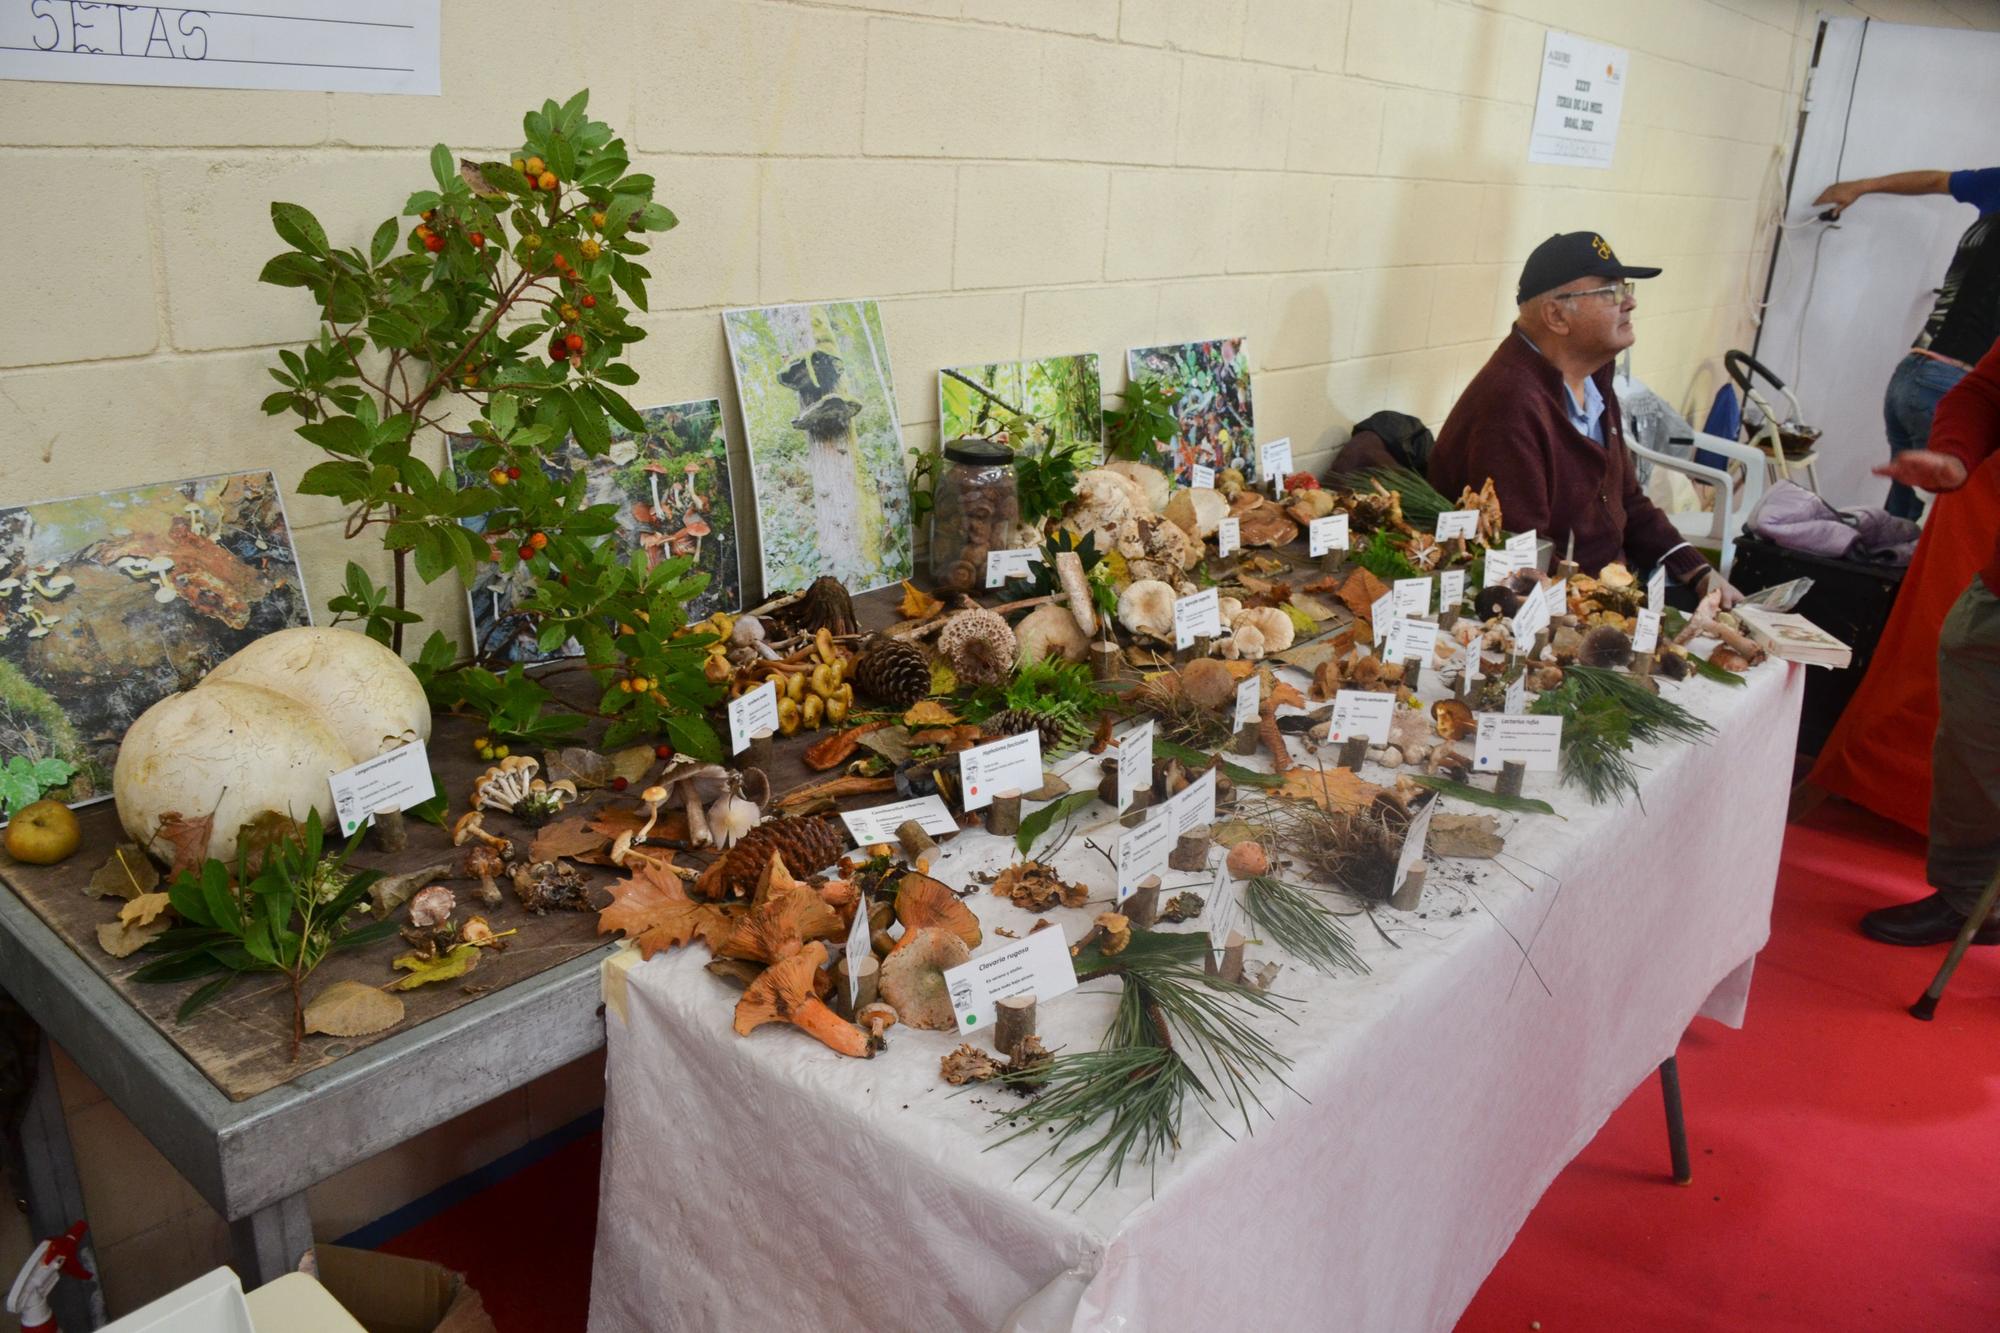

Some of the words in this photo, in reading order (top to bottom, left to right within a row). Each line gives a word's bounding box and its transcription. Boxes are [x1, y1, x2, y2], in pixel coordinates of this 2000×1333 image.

[31, 0, 210, 60] SETAS
[979, 956, 1006, 972] Clavaria
[1007, 946, 1029, 960] rugosa
